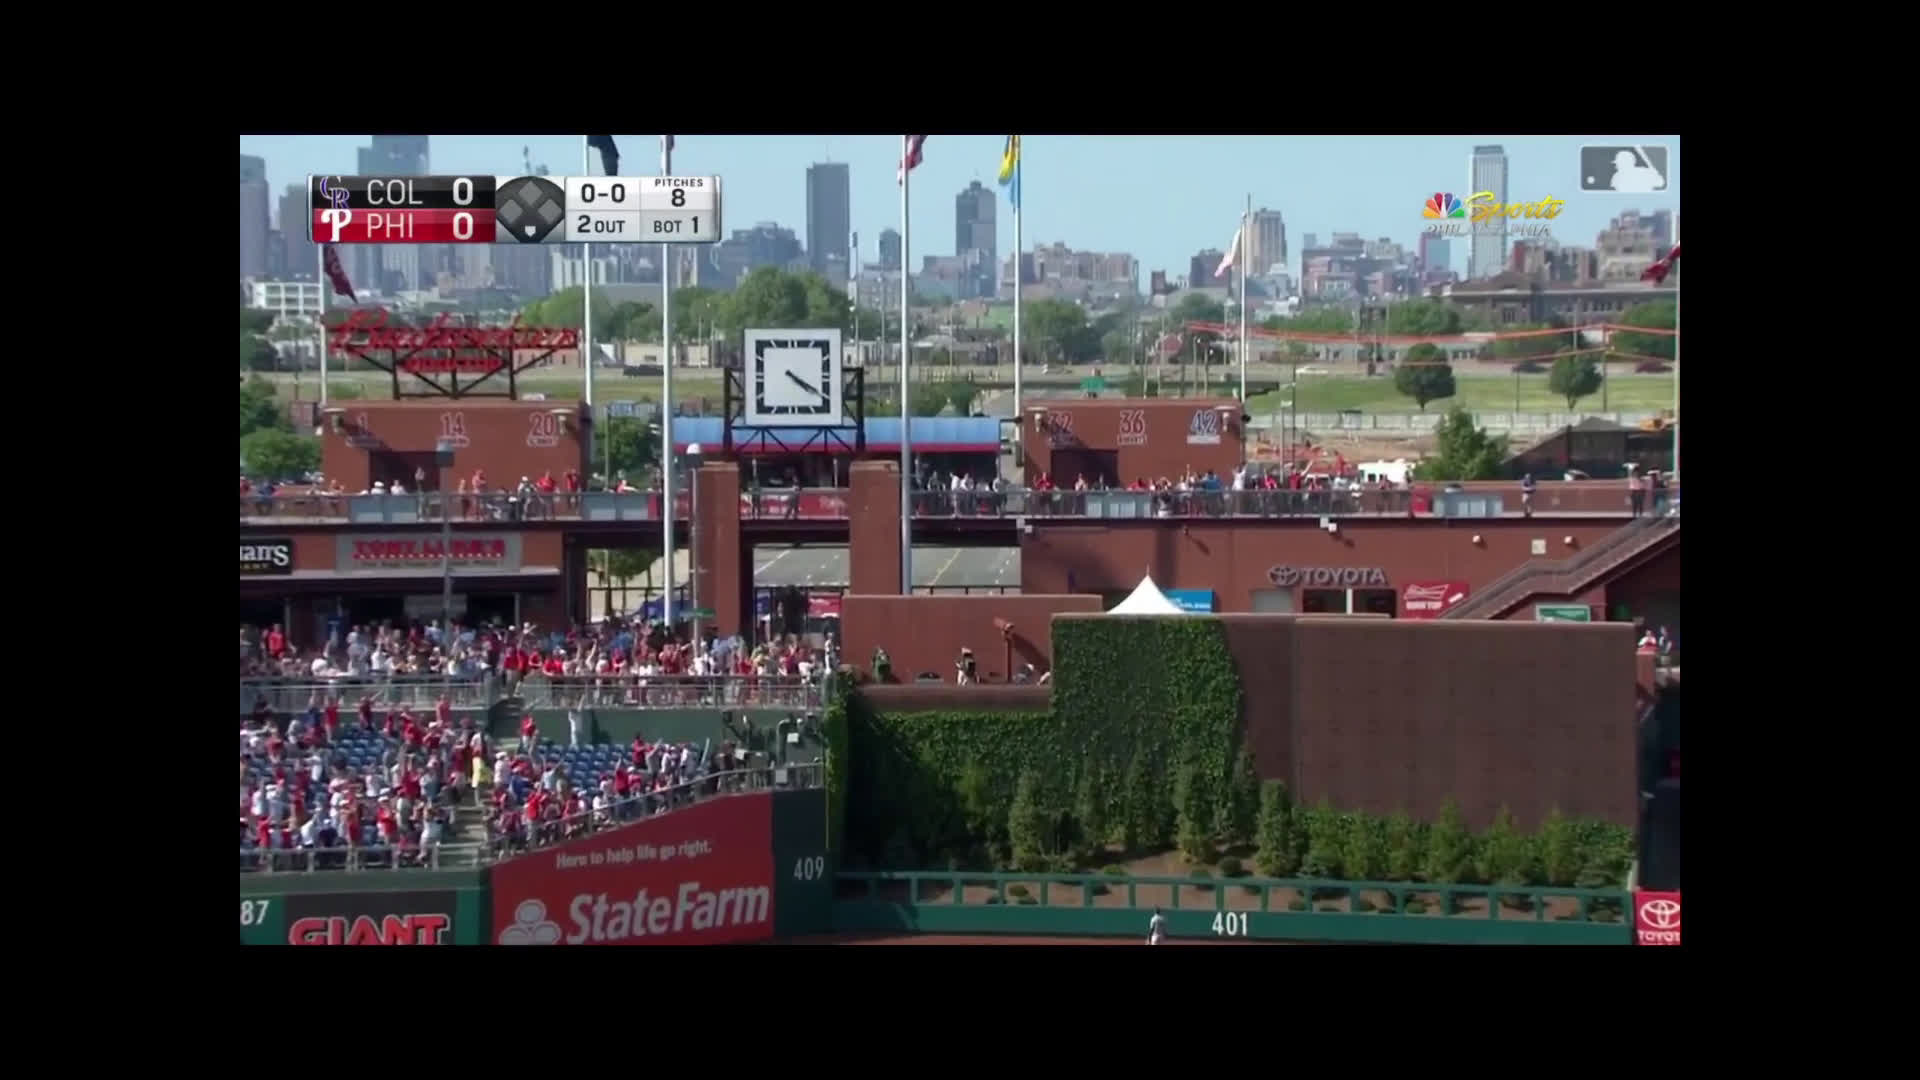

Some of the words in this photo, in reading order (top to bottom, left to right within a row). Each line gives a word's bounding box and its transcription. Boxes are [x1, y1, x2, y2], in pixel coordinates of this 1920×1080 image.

[441, 411, 466, 435] 14
[529, 411, 557, 436] 20
[1119, 409, 1145, 434] 36
[1190, 410, 1217, 435] 42
[1301, 567, 1387, 584] TOYOTA
[556, 852, 588, 869] Here
[590, 850, 603, 865] to
[606, 847, 634, 864] help
[636, 843, 657, 860] life
[659, 845, 676, 861] go
[678, 840, 712, 858] right.
[793, 856, 824, 880] 409
[240, 900, 270, 925] 87
[1211, 911, 1248, 936] 401
[288, 914, 451, 945] GIANT
